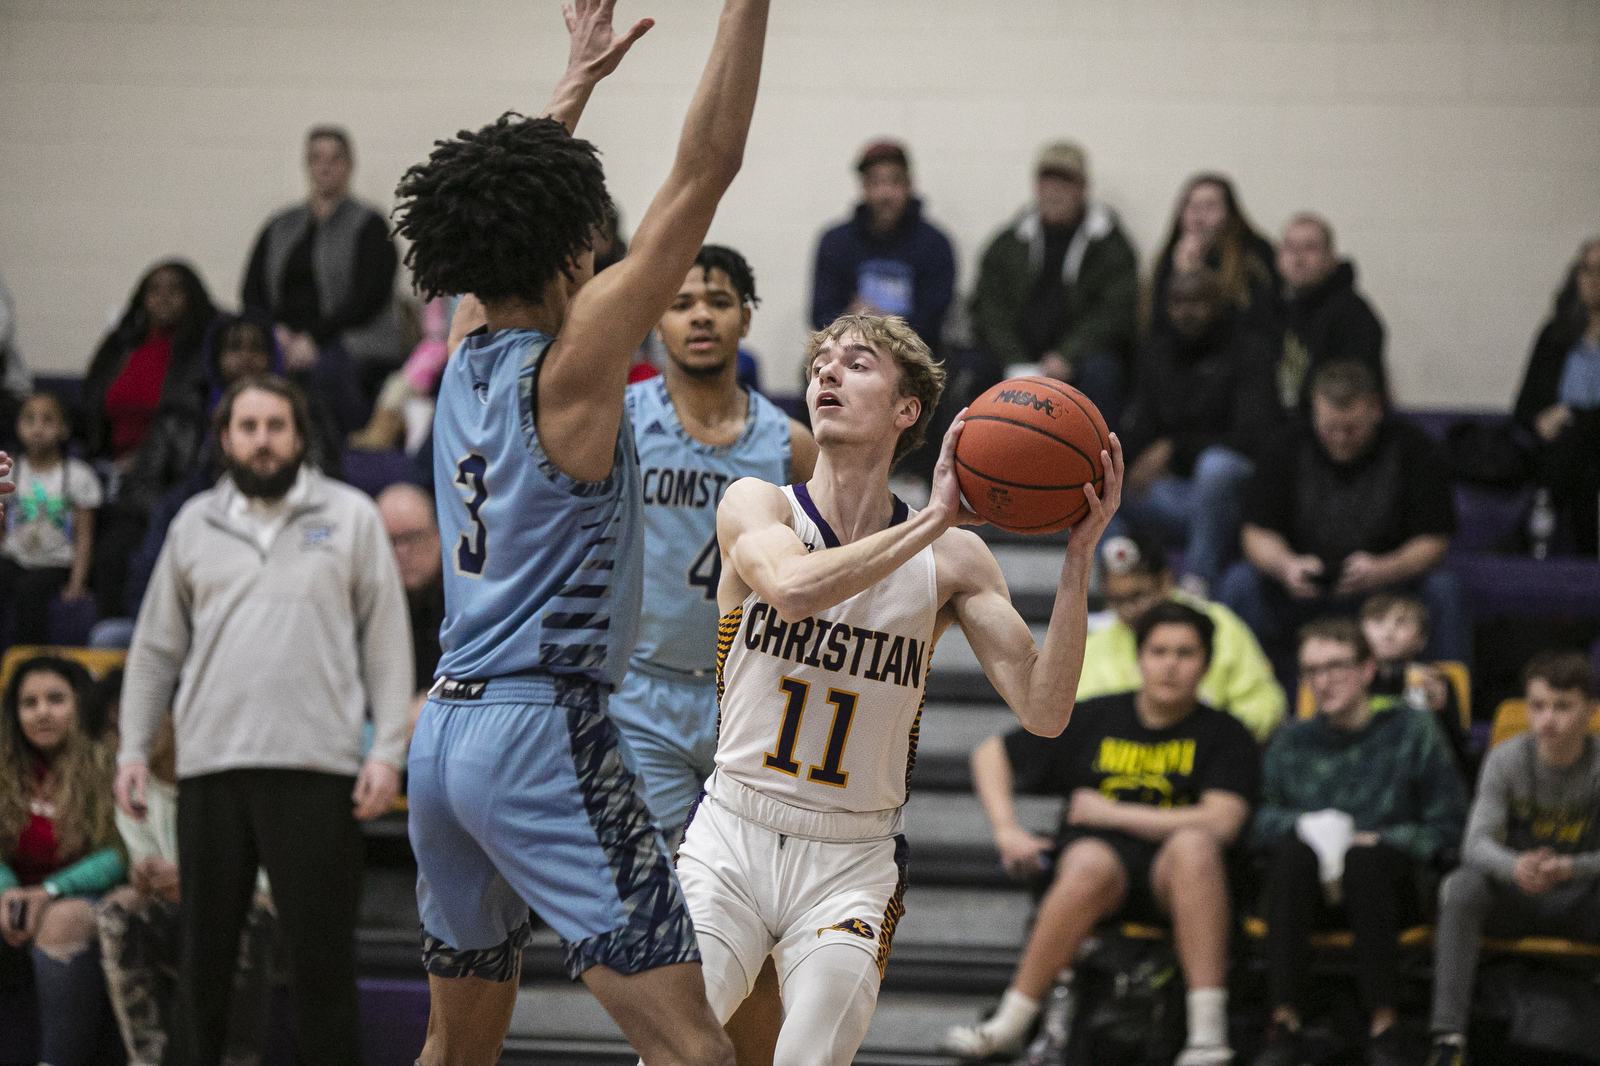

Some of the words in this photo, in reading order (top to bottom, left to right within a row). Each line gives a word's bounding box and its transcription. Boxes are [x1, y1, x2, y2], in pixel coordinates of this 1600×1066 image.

[453, 452, 488, 580] 3
[642, 467, 740, 509] COMST
[687, 532, 722, 601] 4
[744, 602, 926, 689] CHRISTIAN
[762, 675, 860, 789] 11
